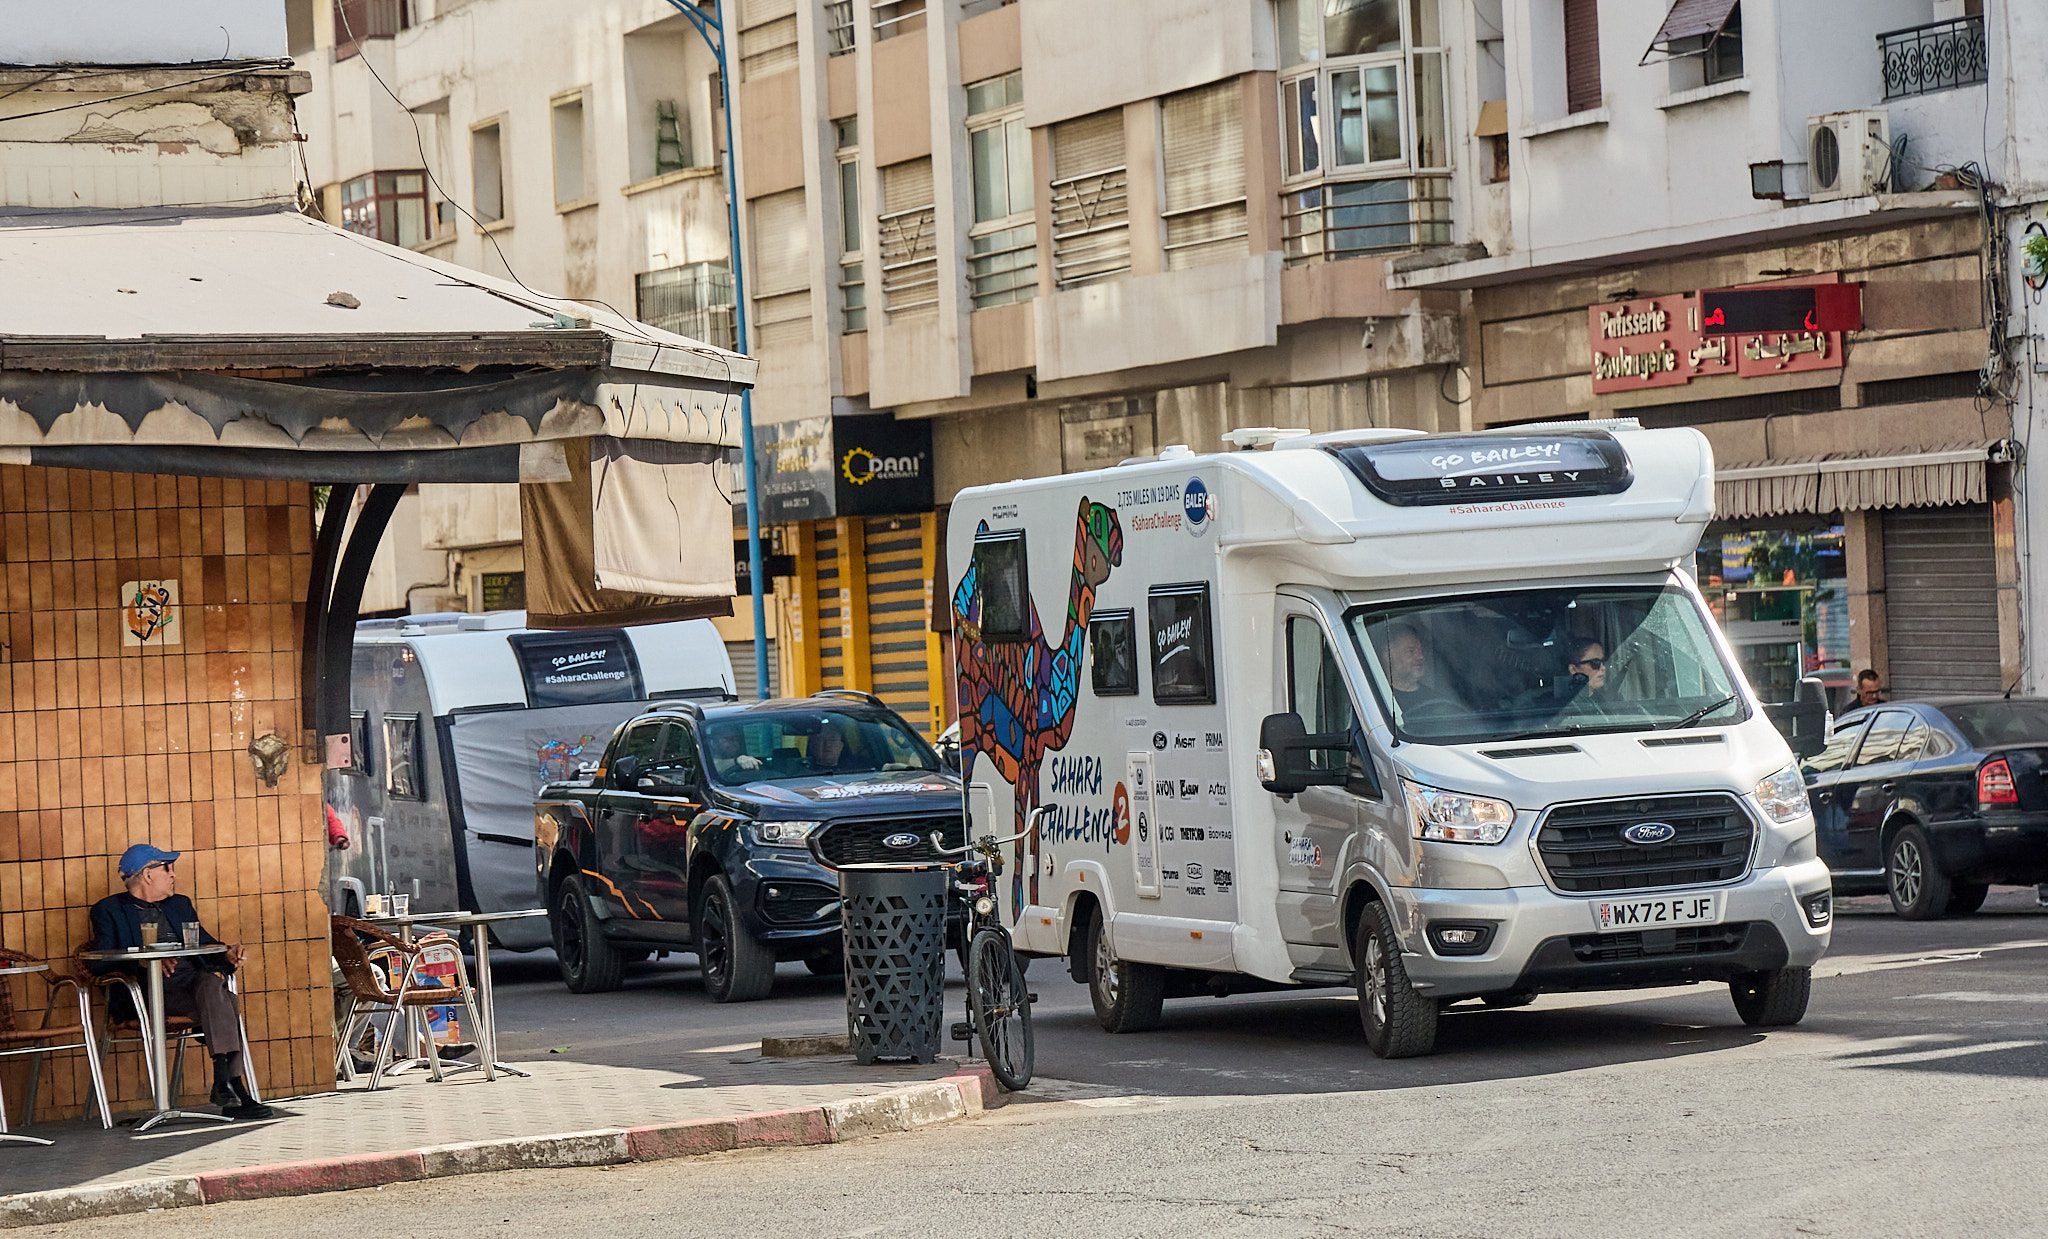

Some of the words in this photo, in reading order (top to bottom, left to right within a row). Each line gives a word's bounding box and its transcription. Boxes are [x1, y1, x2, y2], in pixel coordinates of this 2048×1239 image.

[1600, 302, 1665, 339] Patisserie
[1595, 341, 1675, 380] Boulangerie
[1432, 453, 1464, 469] GO
[1471, 443, 1561, 464] BAILEY!
[1440, 471, 1580, 488] BAILEY
[1133, 488, 1150, 506] MILES
[1150, 487, 1156, 503] IN
[1166, 485, 1179, 501] DAYS
[1185, 492, 1206, 509] BAILEY
[1449, 500, 1566, 515] #SaharaChallenge
[1132, 511, 1181, 532] #SaharaChallenge
[1158, 630, 1166, 652] GO
[552, 657, 566, 666] GO
[568, 649, 606, 663] BAILEY!
[545, 671, 625, 684] #SaharaChallenge
[1051, 755, 1102, 796] SAHARA
[1040, 805, 1118, 853] CHALLENGE
[1117, 796, 1128, 830] 2
[1637, 825, 1665, 839] Ford
[891, 836, 912, 846] Ford
[1613, 902, 1666, 925] WX72
[1672, 898, 1711, 920] FJF
